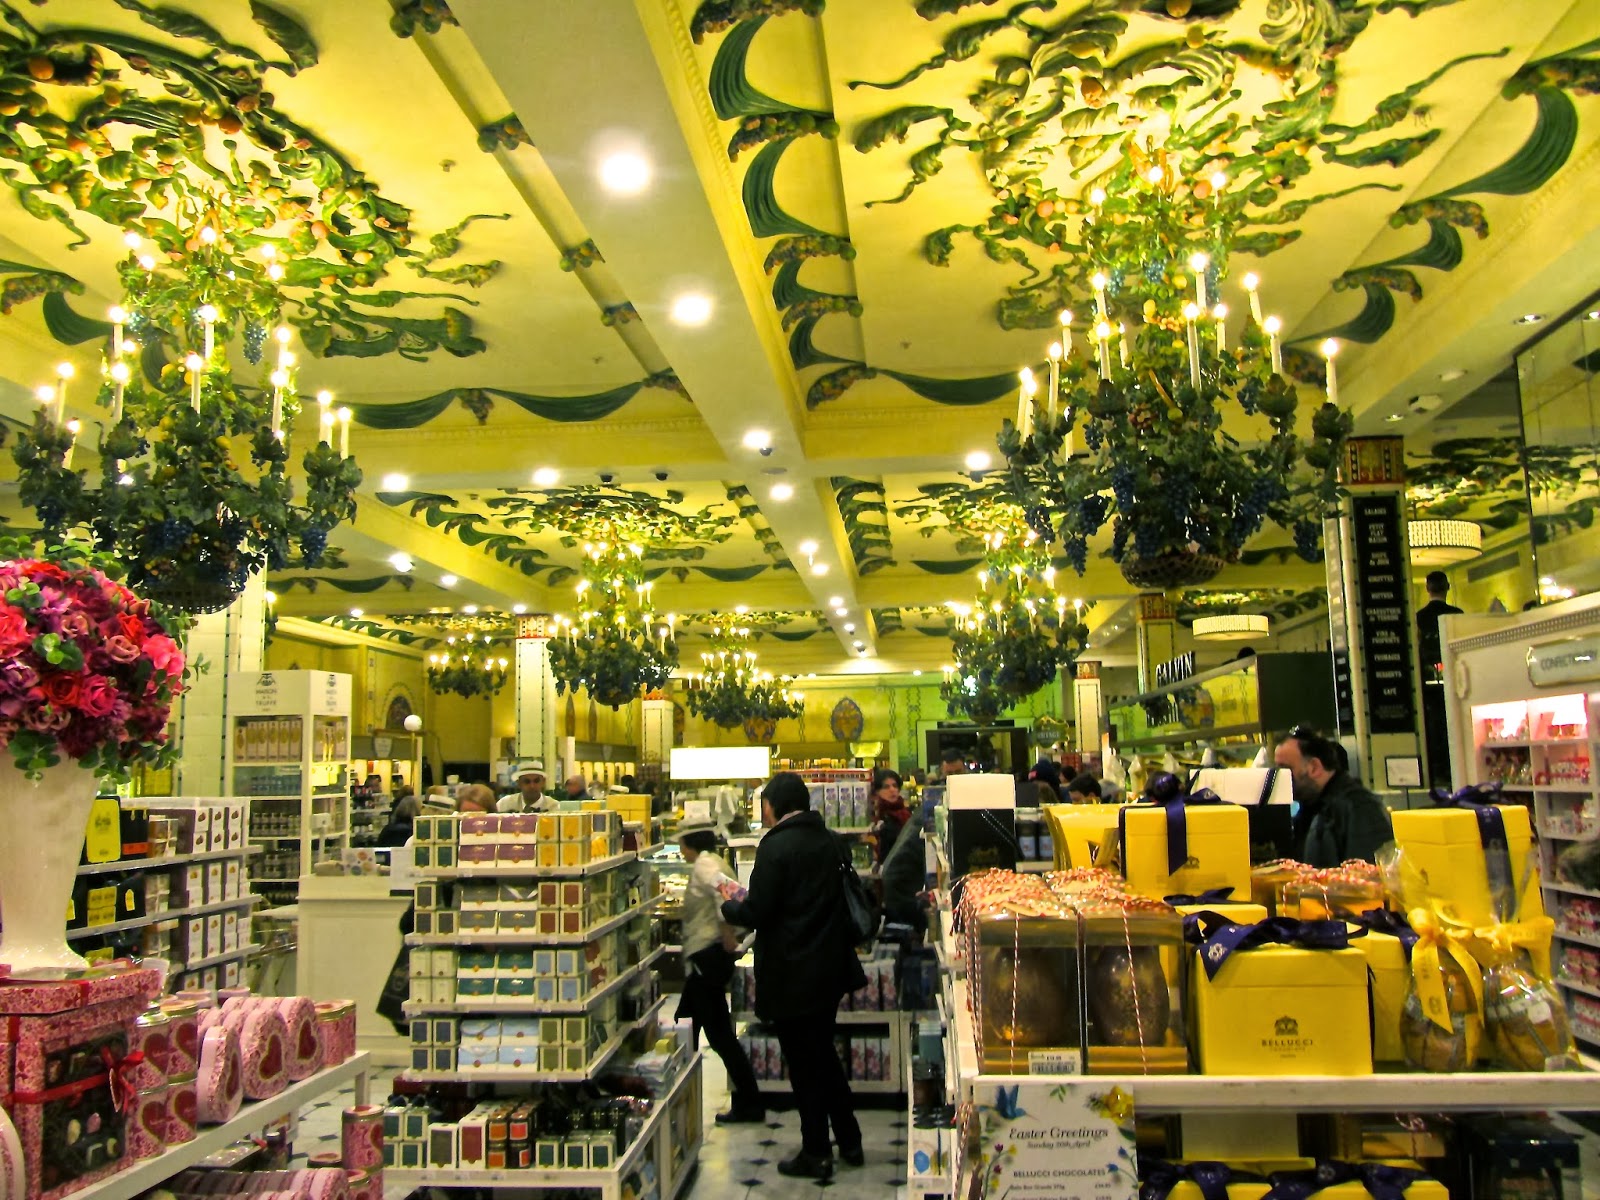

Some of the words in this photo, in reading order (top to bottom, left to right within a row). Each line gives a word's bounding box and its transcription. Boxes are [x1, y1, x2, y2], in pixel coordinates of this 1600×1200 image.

[1261, 1039, 1313, 1047] BELLUCCI
[1009, 1127, 1047, 1140] Easter
[1050, 1126, 1109, 1142] Greetings
[1013, 1170, 1051, 1179] BELLUCCI
[1052, 1168, 1106, 1178] CHOCOLATES
